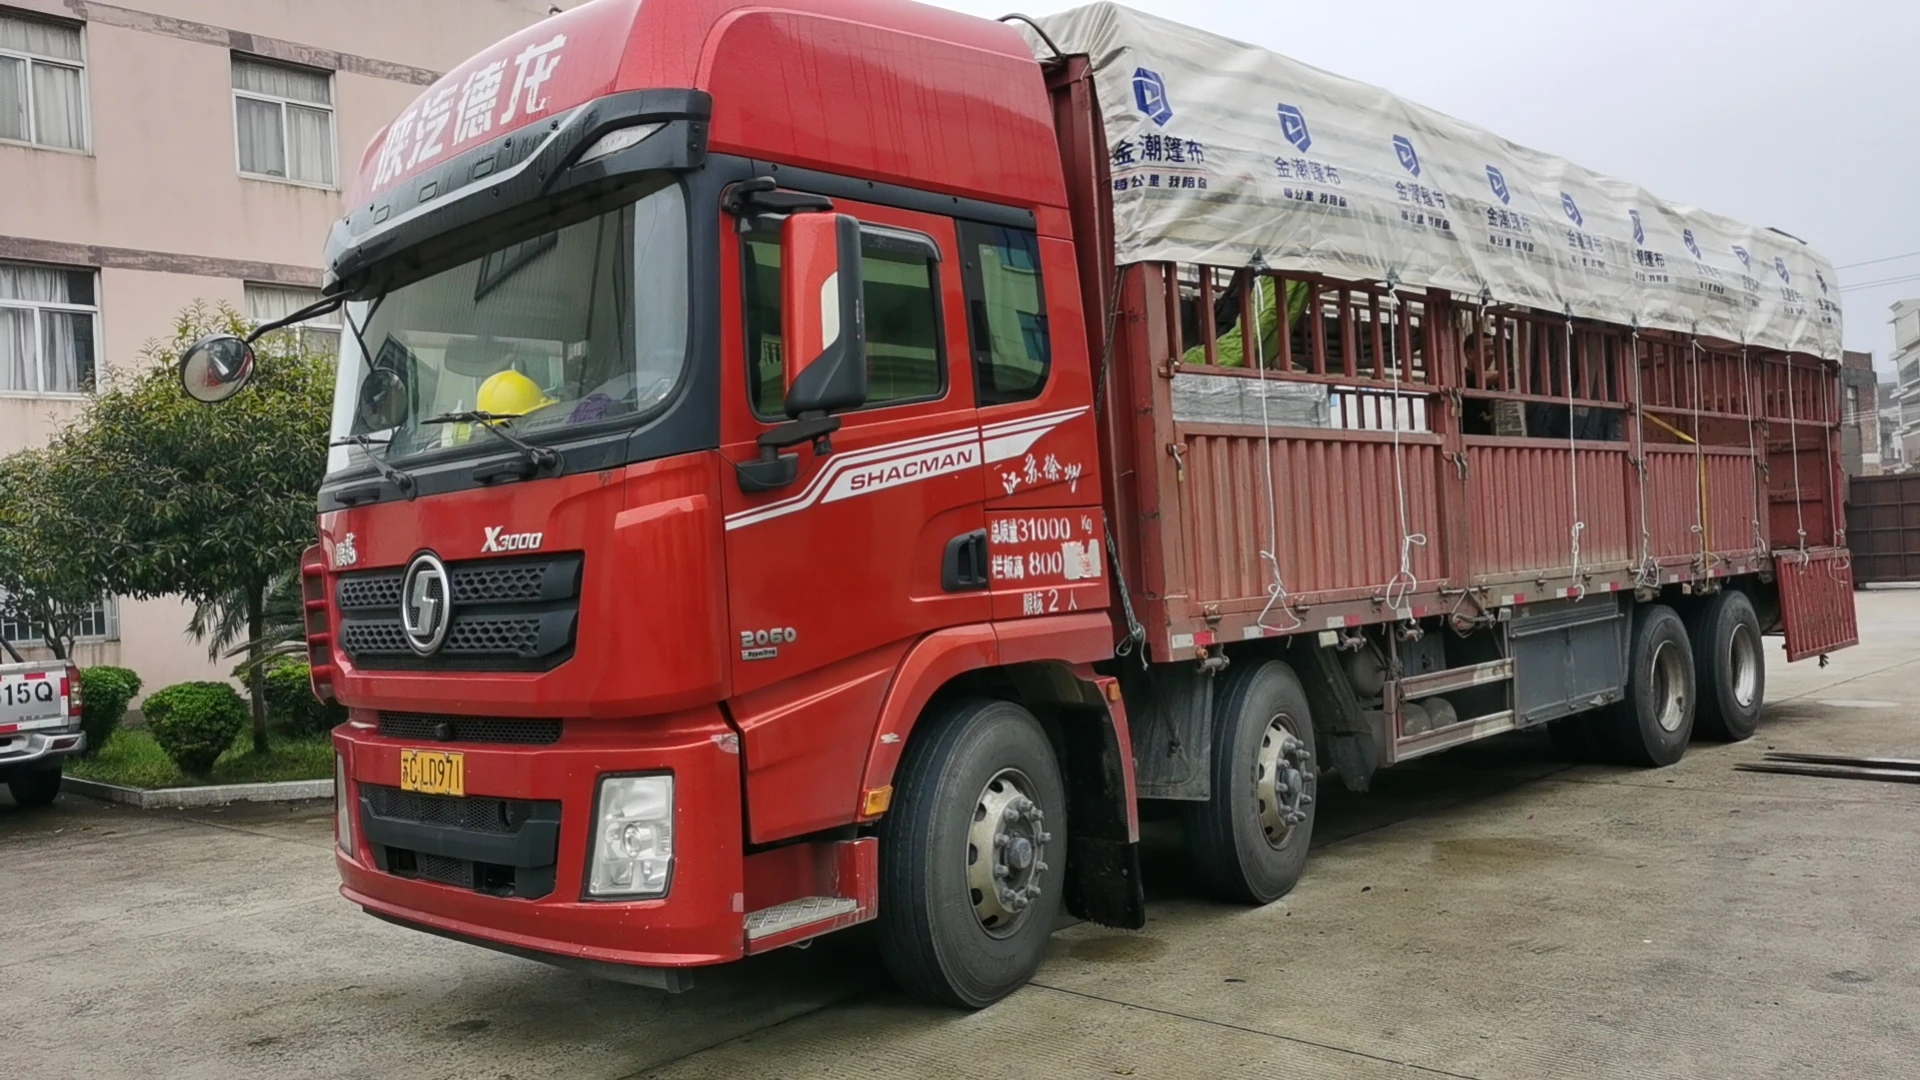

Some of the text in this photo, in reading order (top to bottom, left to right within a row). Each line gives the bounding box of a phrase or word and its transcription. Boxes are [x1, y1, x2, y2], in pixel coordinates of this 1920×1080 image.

[371, 34, 567, 192] 陕汽德龙
[1111, 133, 1204, 166] 金潮篷布
[1114, 174, 1160, 190] 每公里
[1274, 156, 1341, 185] 金潮篷布
[850, 449, 973, 491] SHACMAN
[1001, 453, 1082, 495] 江苏徐州
[481, 525, 543, 553] X3000
[992, 555, 1024, 580] 栏板高
[1048, 589, 1059, 612] 2
[1068, 589, 1078, 611] 人
[740, 626, 797, 647] 2060
[0, 681, 53, 706] 15Q
